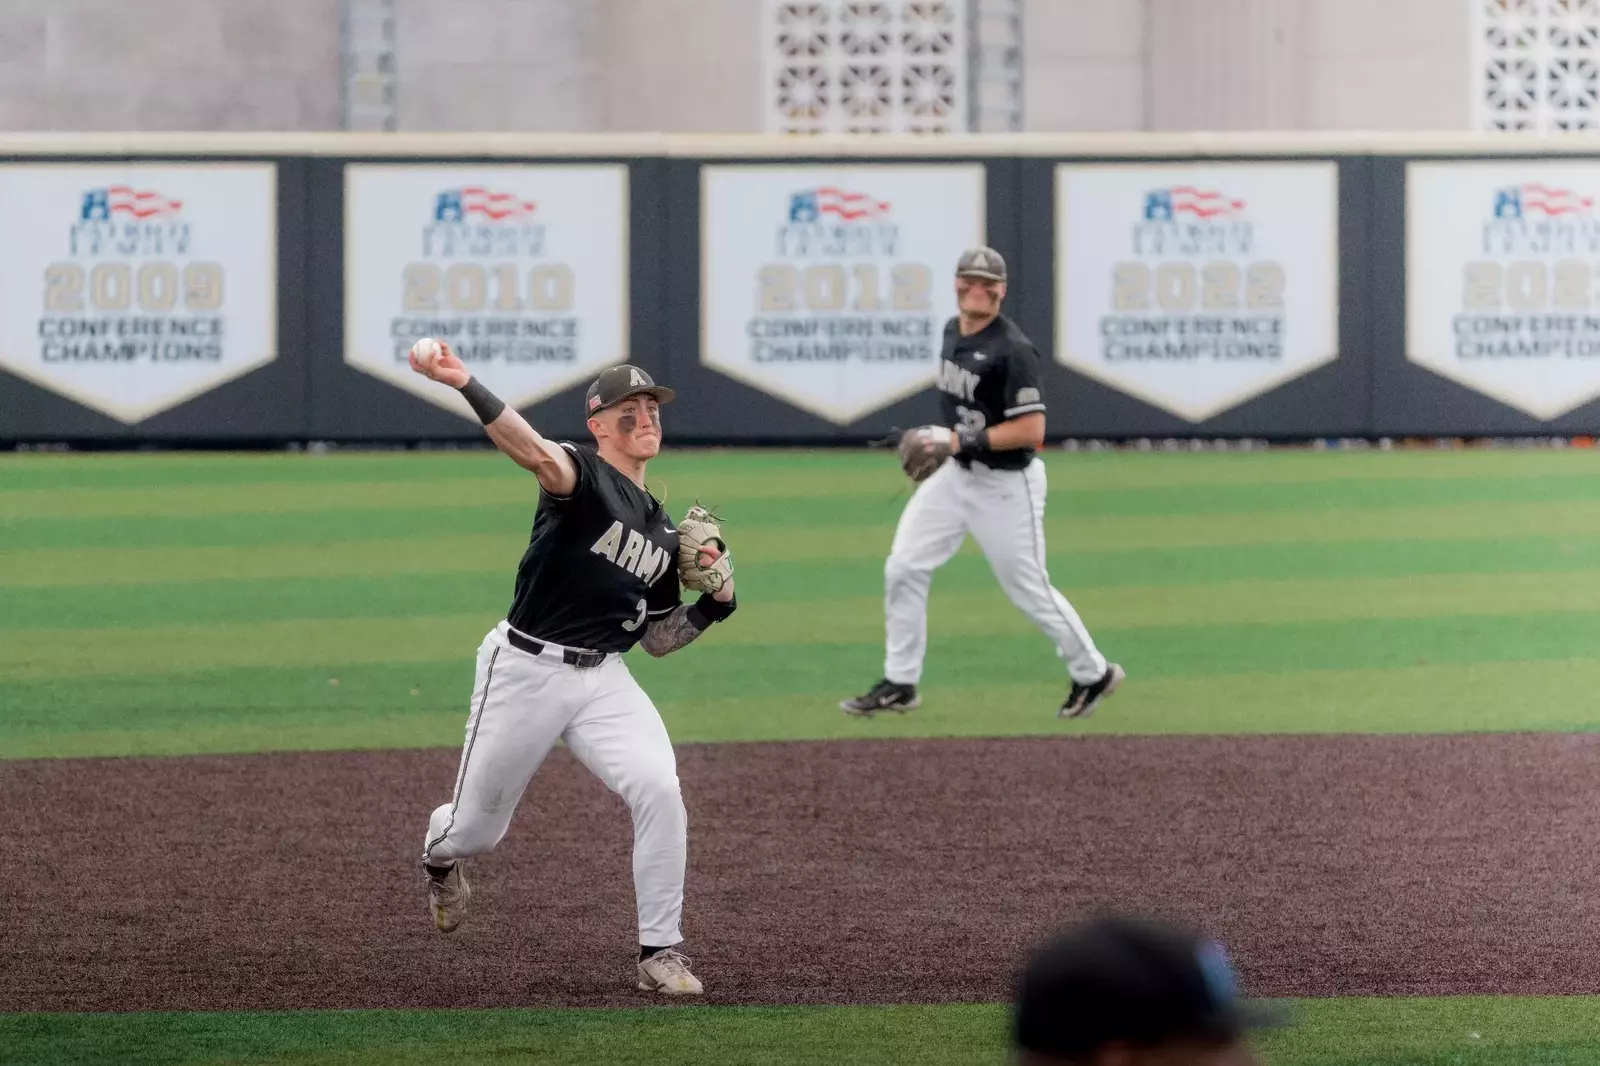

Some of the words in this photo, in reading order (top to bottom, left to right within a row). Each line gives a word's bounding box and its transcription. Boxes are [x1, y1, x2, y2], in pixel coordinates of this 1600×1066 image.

[974, 252, 989, 269] A
[43, 262, 224, 312] 2009
[402, 263, 575, 312] 2010
[756, 263, 932, 312] 2012
[1111, 262, 1286, 311] 2022
[38, 317, 223, 338] CONFERENCE
[391, 317, 578, 339] CONFERENCE
[748, 317, 933, 338] CONFERENCE
[1100, 316, 1285, 336] CONFERENCE
[42, 341, 222, 362] CHAMPIONS
[753, 341, 933, 362] CHAMPIONS
[1103, 340, 1284, 361] CHAMPIONS
[630, 368, 647, 387] A
[590, 520, 671, 588] ARMY
